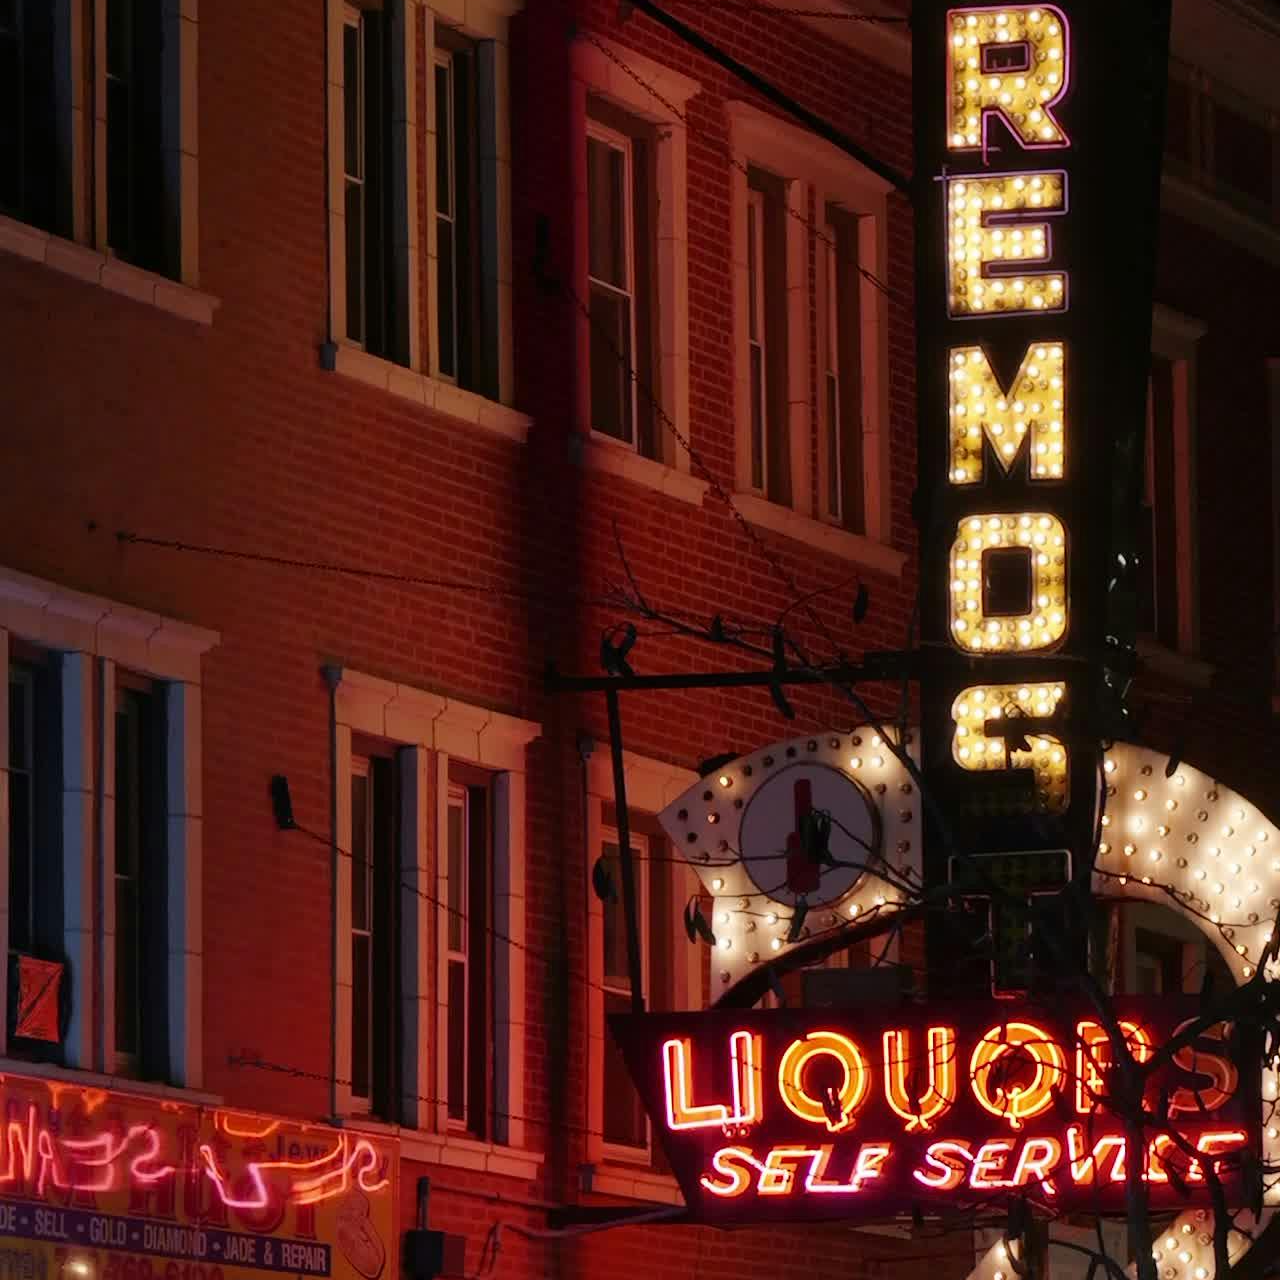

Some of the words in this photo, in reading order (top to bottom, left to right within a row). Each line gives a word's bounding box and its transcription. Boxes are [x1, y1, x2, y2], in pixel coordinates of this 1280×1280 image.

[662, 1016, 1240, 1131] LIQUORS
[701, 1142, 890, 1196] SELF
[34, 1208, 69, 1238] SELL
[88, 1216, 128, 1246] GOLD
[143, 1224, 207, 1258] DIAMOND
[223, 1233, 257, 1265] JADE
[263, 1240, 273, 1264] &
[280, 1242, 328, 1272] REPAIR
